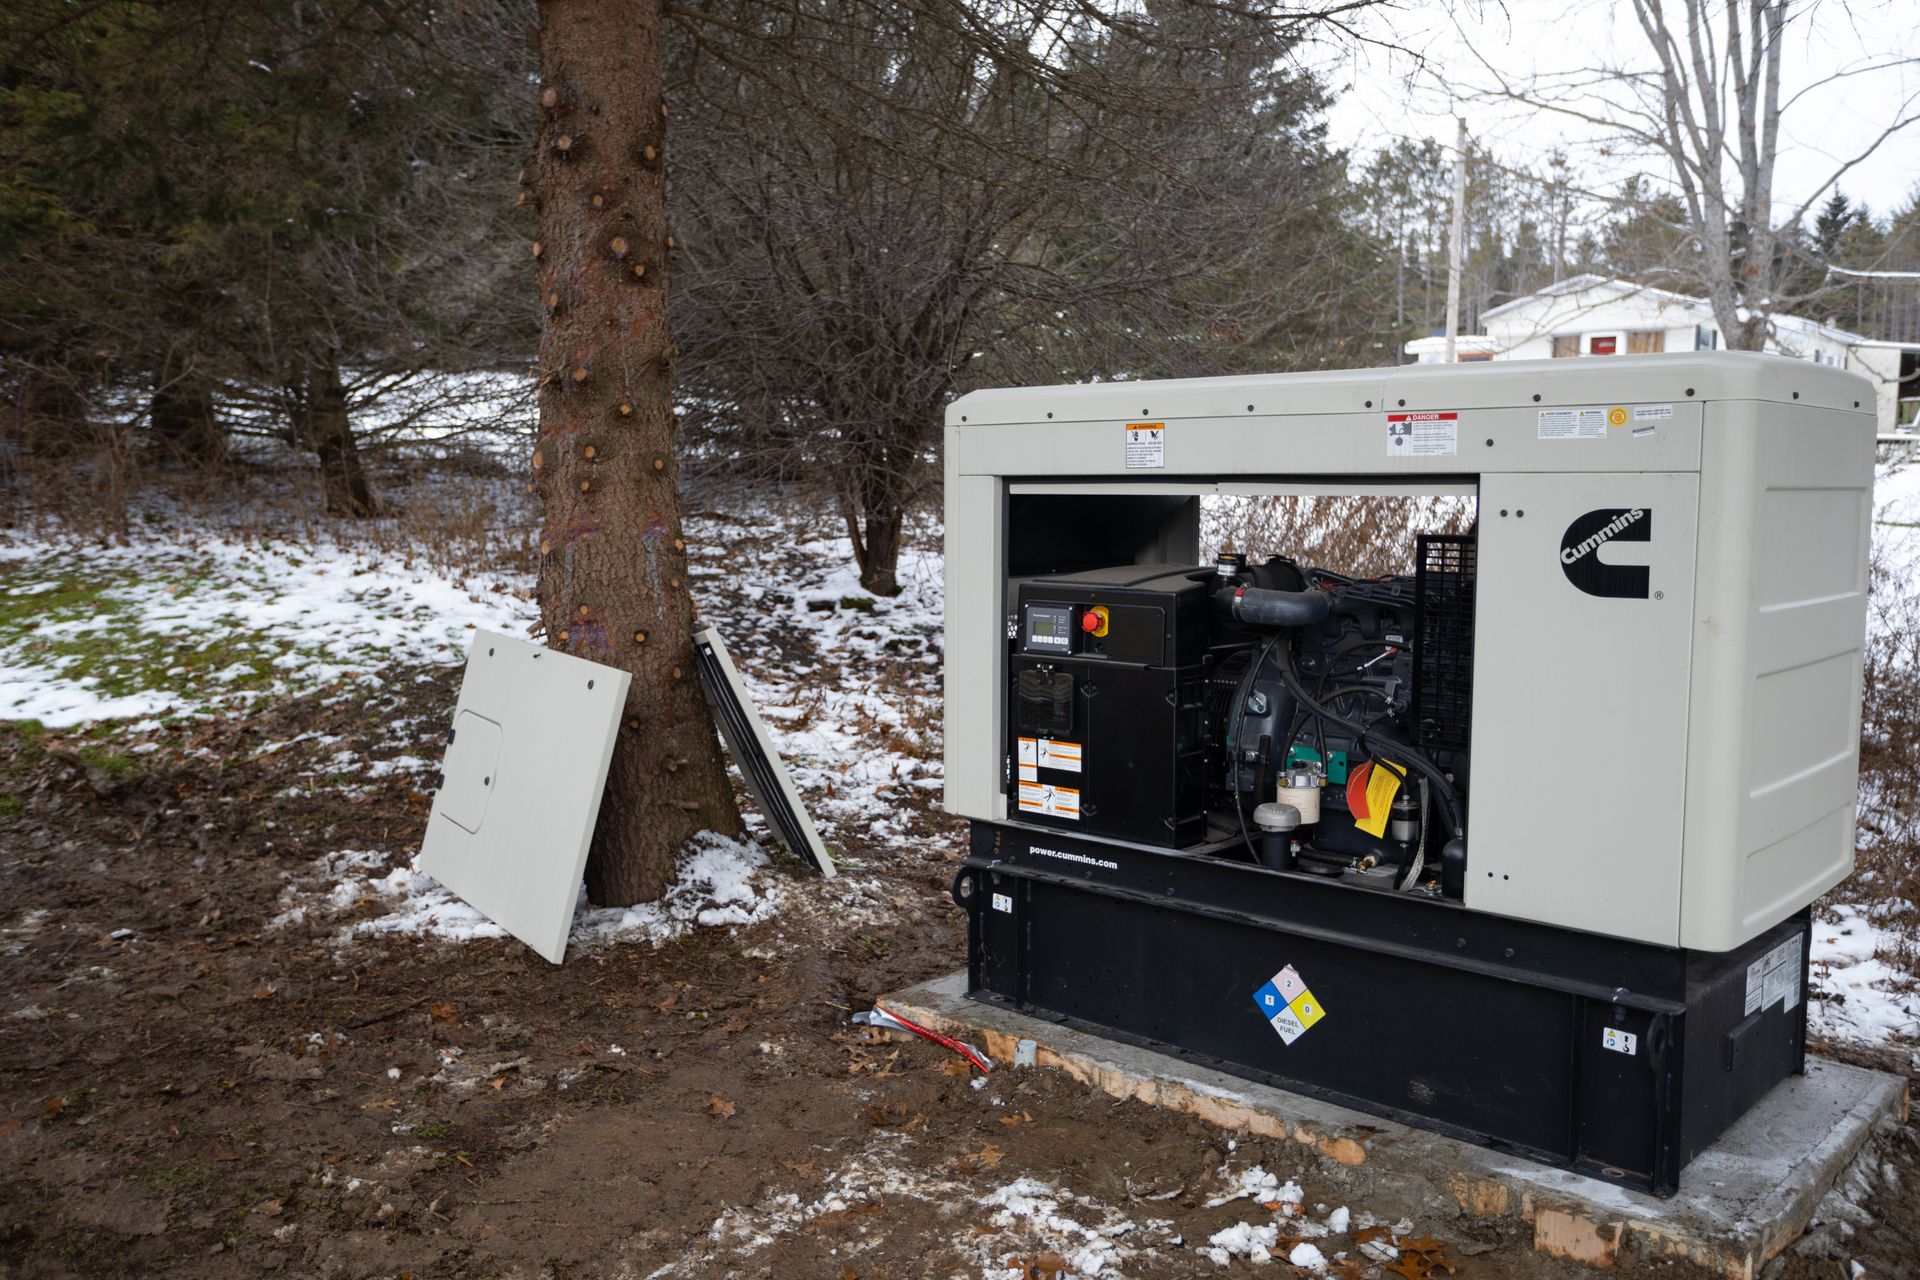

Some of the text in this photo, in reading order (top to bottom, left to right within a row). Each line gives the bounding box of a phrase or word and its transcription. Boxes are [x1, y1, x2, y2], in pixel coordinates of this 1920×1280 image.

[1560, 508, 1643, 564] Cummins
[1029, 845, 1117, 869] power.cummins.com
[1277, 1017, 1299, 1028] DIESEL
[1280, 1025, 1296, 1035] FUEL
